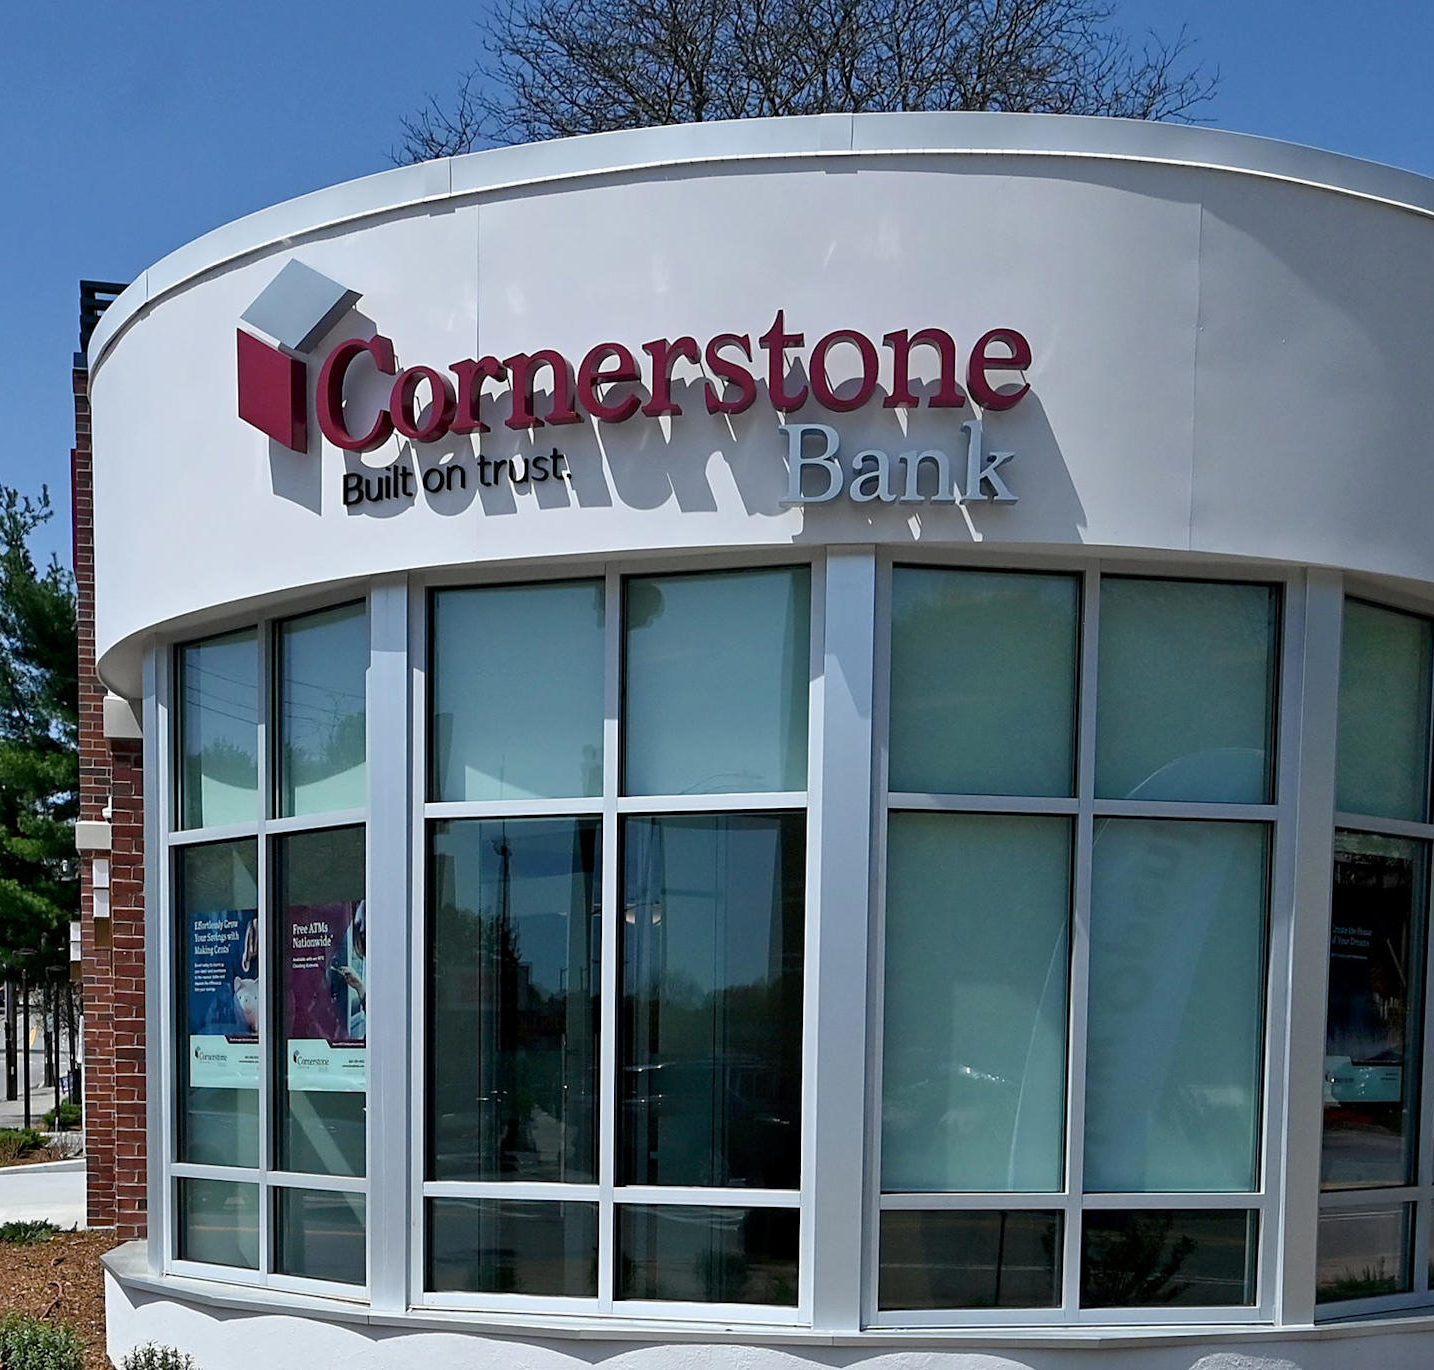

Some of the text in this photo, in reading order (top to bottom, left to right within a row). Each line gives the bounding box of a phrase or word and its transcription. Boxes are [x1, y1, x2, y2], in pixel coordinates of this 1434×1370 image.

[316, 310, 1032, 453] Cornerstone
[343, 448, 572, 506] Built on trust.
[778, 419, 1019, 505] Bank
[293, 922, 328, 935] Free ATMs
